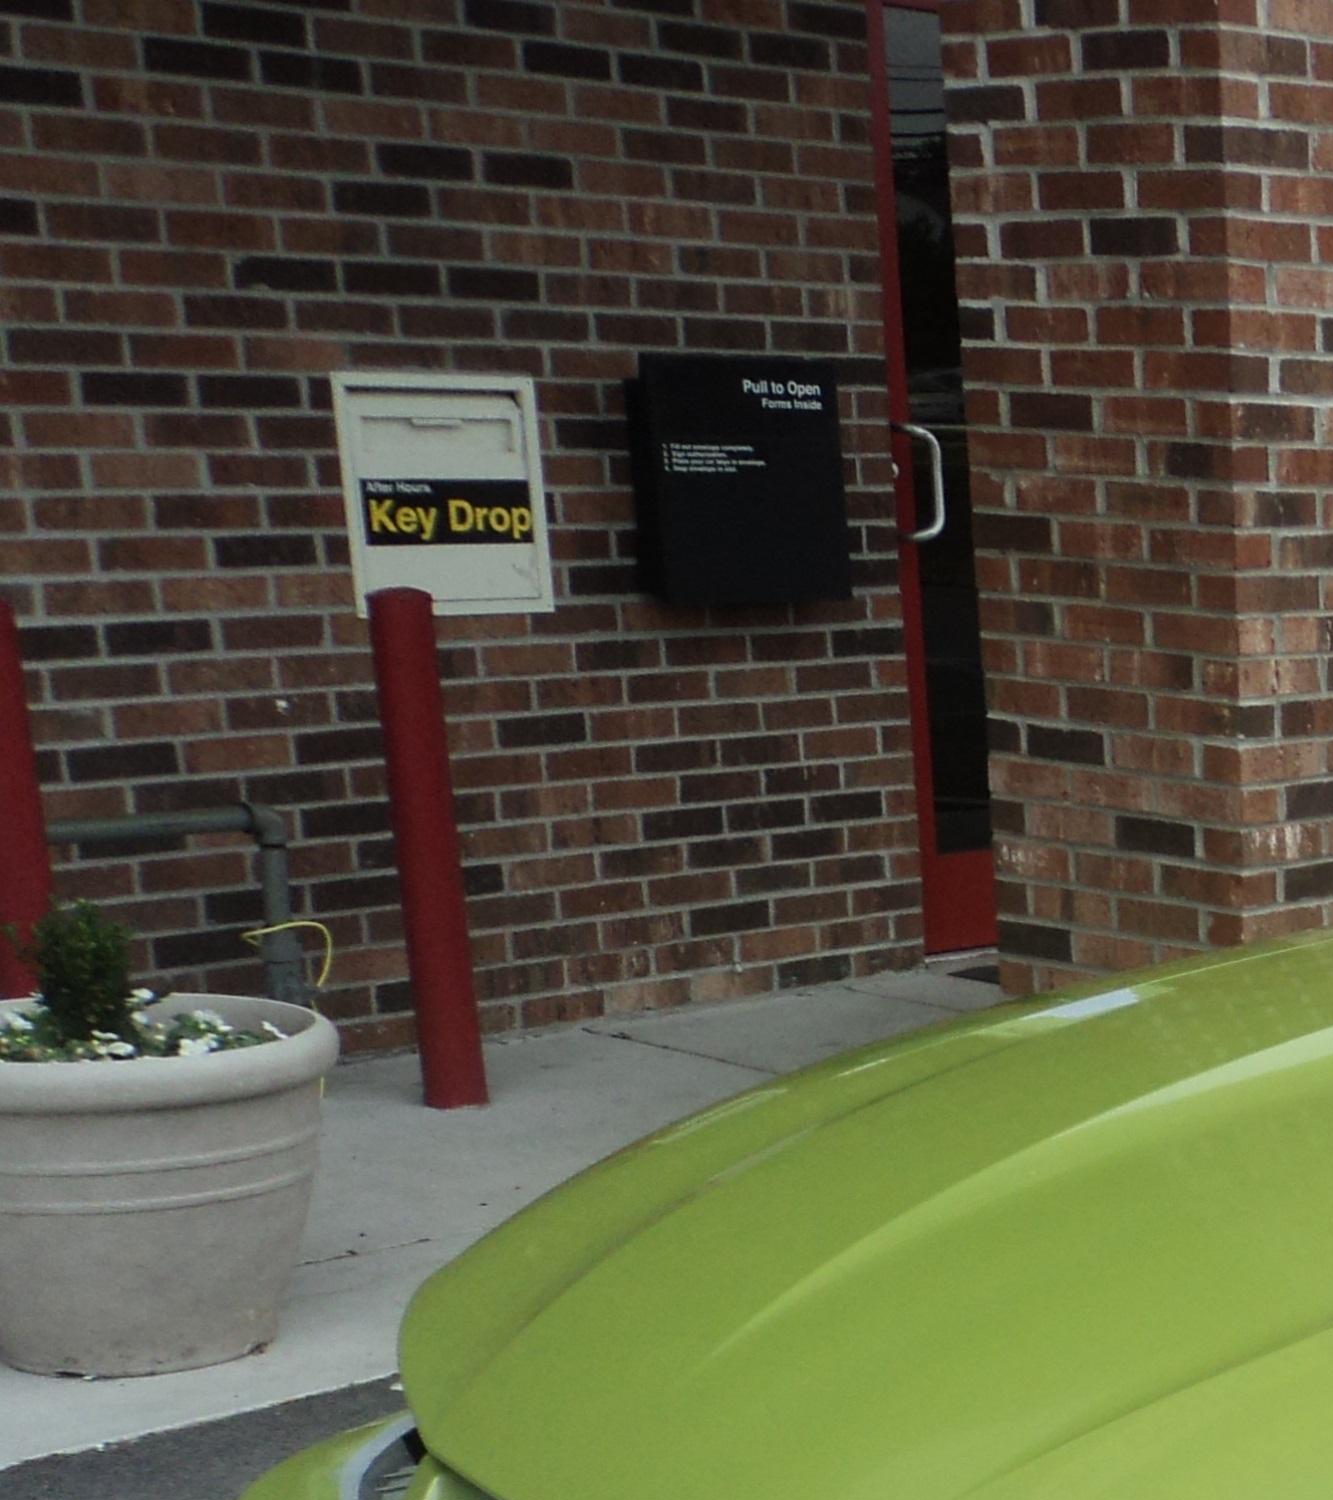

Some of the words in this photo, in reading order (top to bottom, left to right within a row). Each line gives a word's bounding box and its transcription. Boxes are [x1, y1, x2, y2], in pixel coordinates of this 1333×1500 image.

[742, 379, 768, 394] Pull
[770, 381, 785, 395] to
[787, 380, 821, 398] Open
[761, 398, 793, 409] Forms
[794, 399, 823, 411] Inside
[366, 481, 393, 493] After
[395, 482, 433, 494] Hours
[368, 499, 438, 541] Key
[448, 499, 533, 540] Drop
